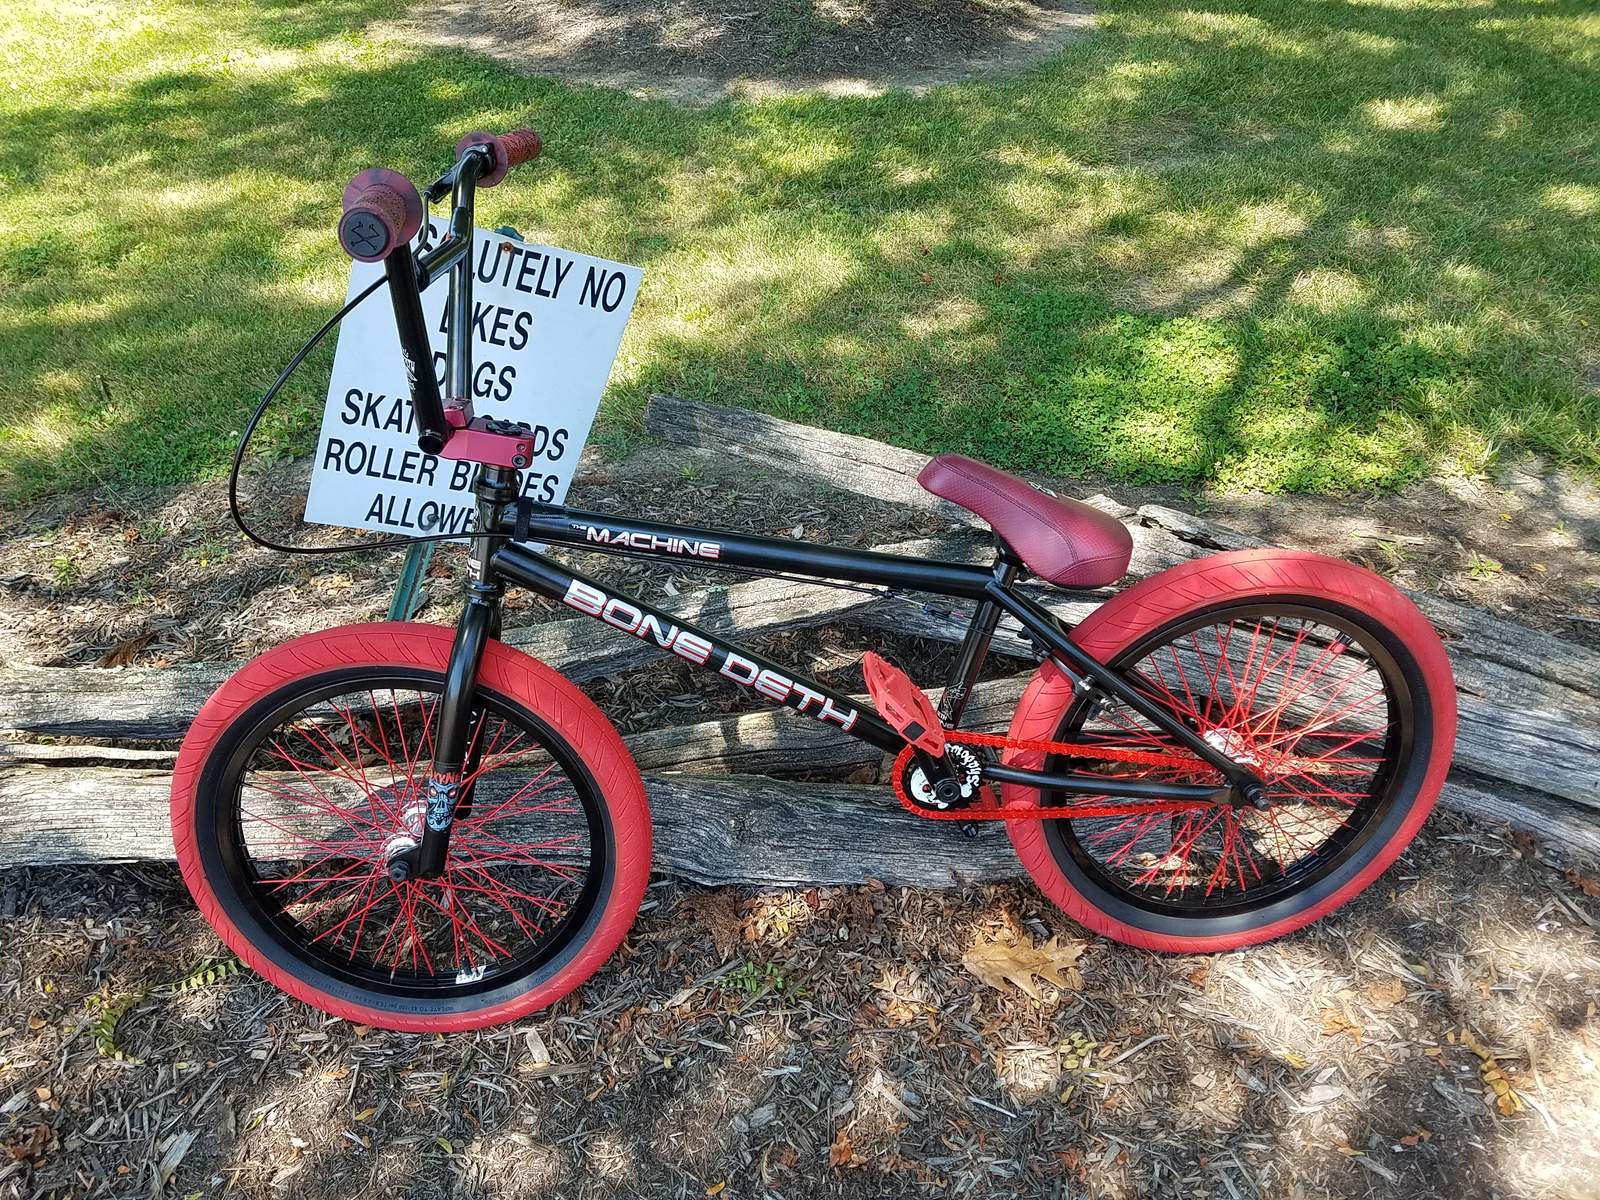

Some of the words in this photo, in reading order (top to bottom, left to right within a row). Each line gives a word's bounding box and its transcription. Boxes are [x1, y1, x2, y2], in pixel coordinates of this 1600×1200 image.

[579, 266, 626, 313] NO
[439, 295, 533, 351] KES
[433, 351, 517, 402] DGS
[341, 388, 569, 461] SKATDS
[323, 437, 439, 487] ROLLER
[364, 493, 475, 534] ALLOWE
[586, 526, 720, 560] MACHINE
[563, 578, 713, 667] BONE
[719, 651, 858, 732] DETH
